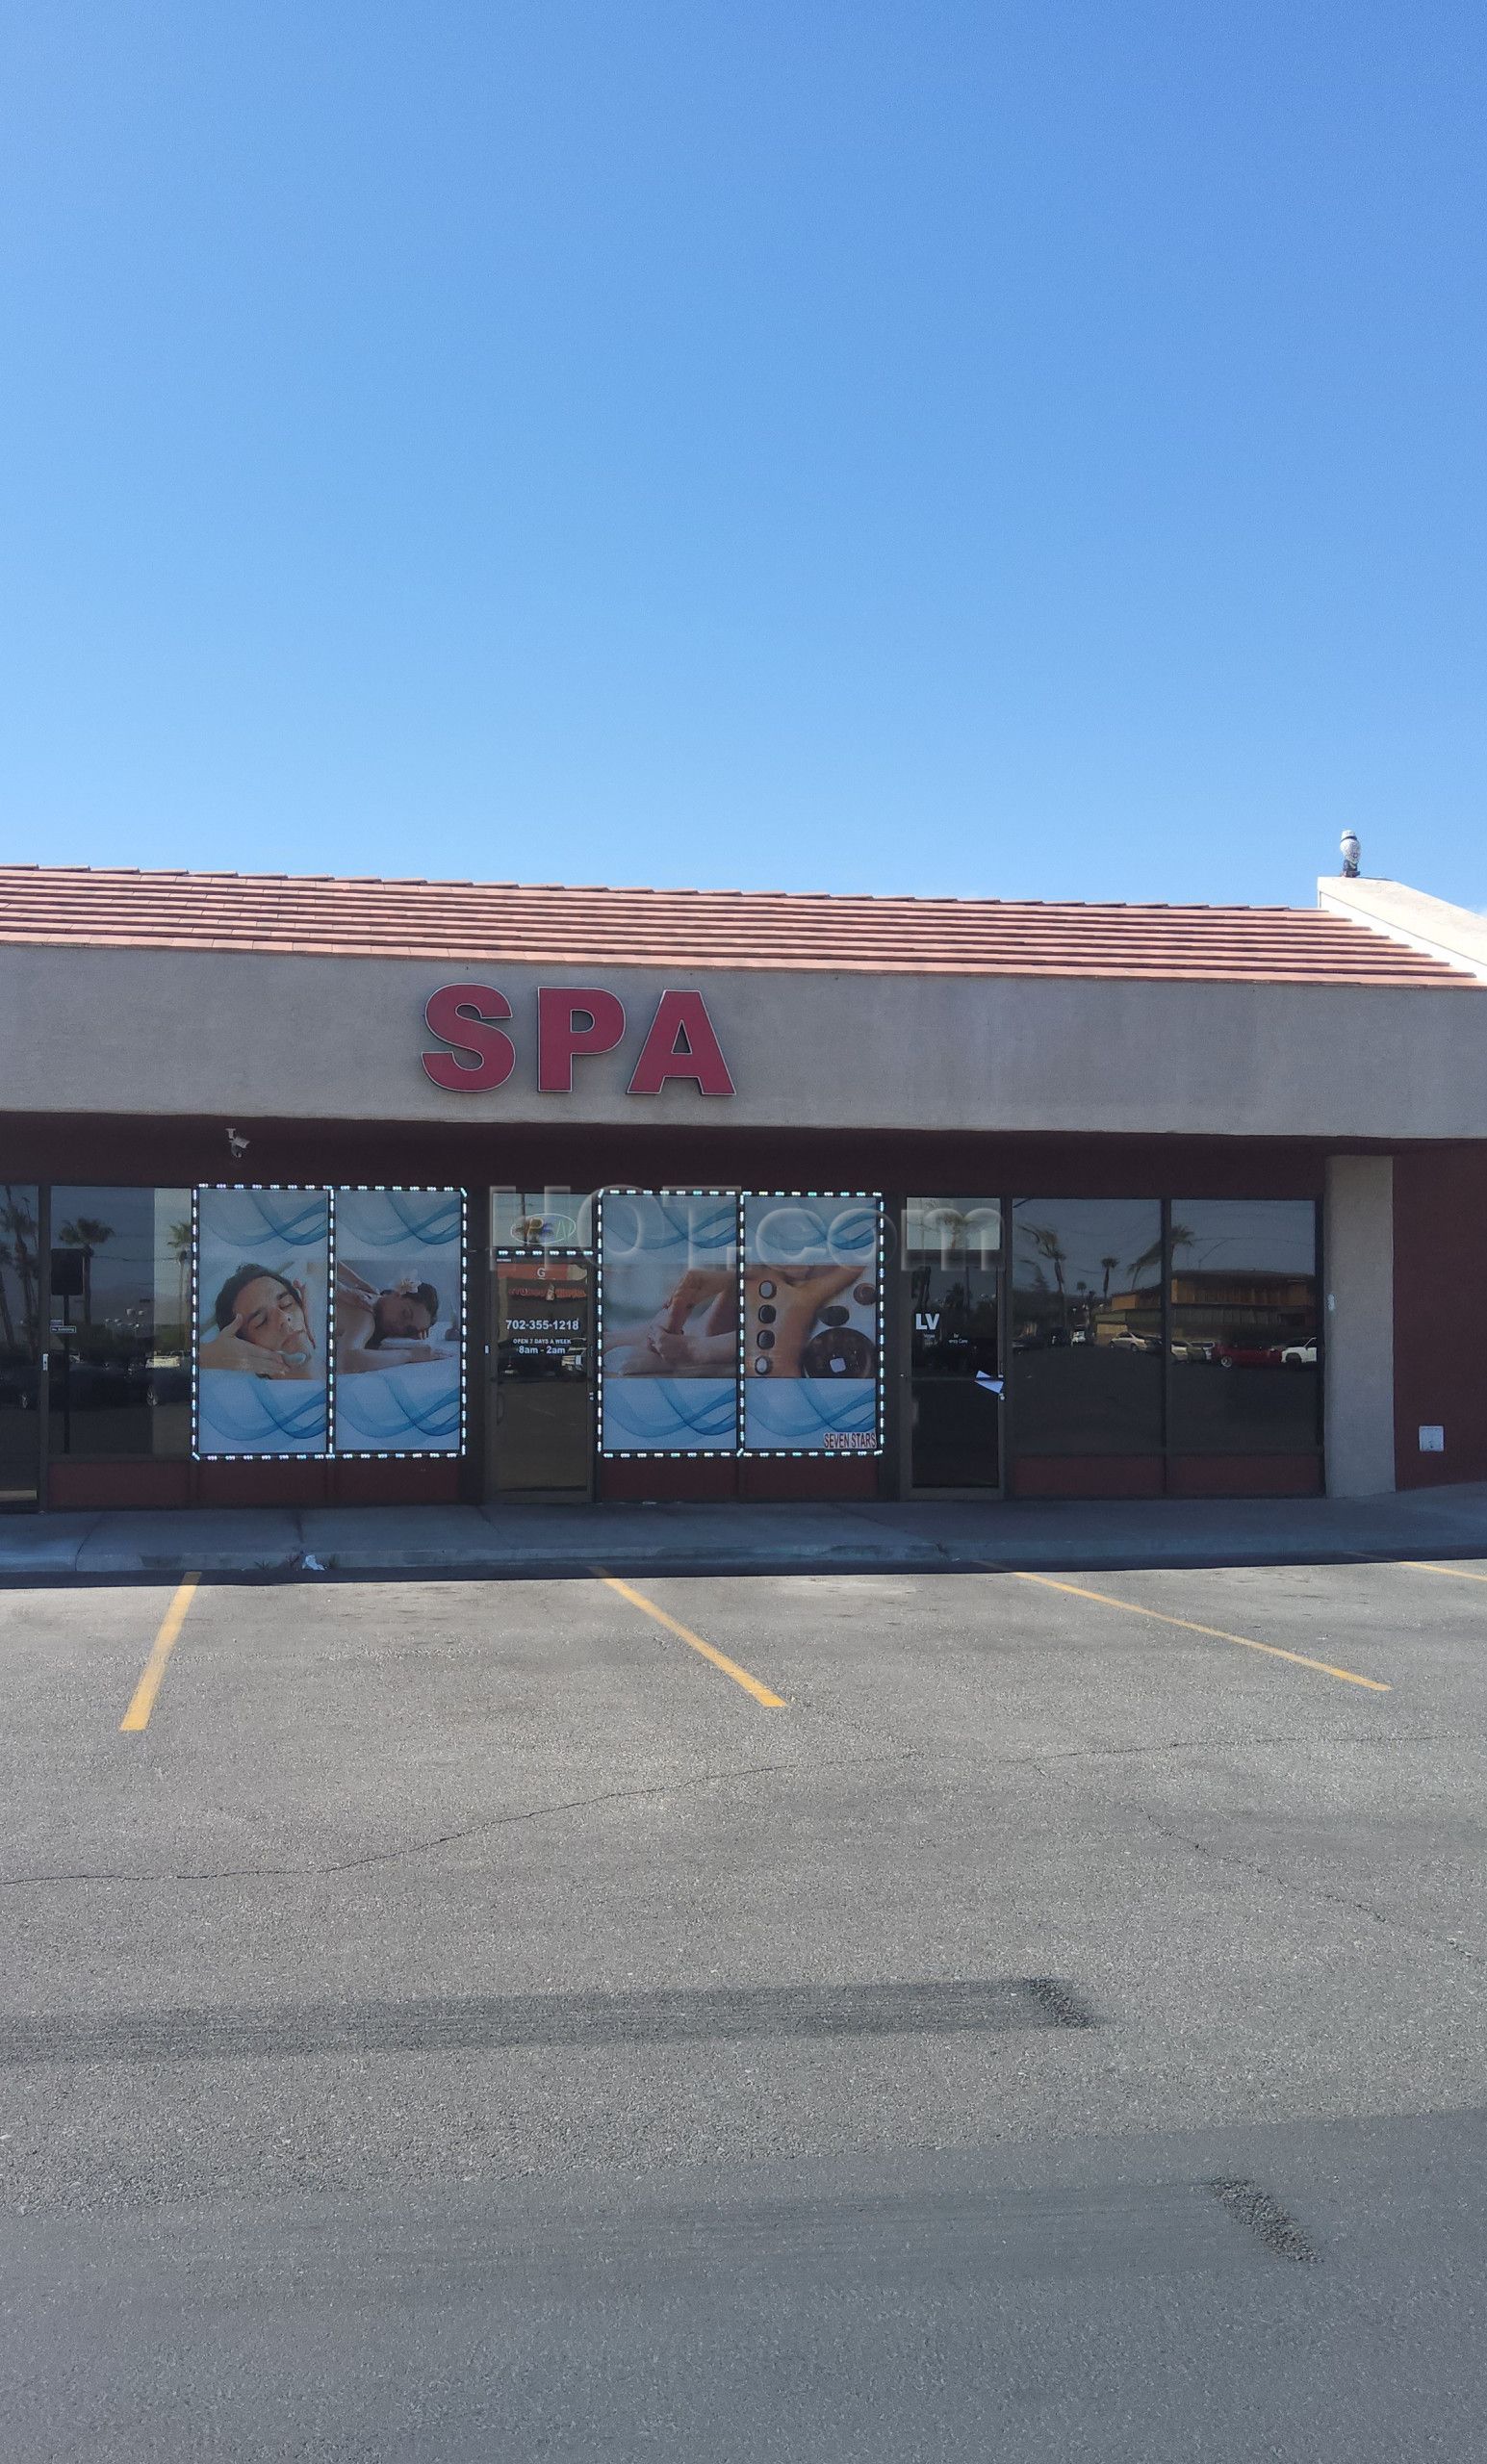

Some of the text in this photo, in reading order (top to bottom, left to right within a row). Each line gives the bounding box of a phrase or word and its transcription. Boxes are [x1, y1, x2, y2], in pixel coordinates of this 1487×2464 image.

[421, 982, 737, 1096] SPA
[505, 1320, 579, 1330] 702-355-1218
[915, 1313, 940, 1330] LV
[519, 1346, 539, 1354] 8am
[546, 1346, 566, 1354] 2am
[824, 1432, 877, 1449] SEVEN STARS
